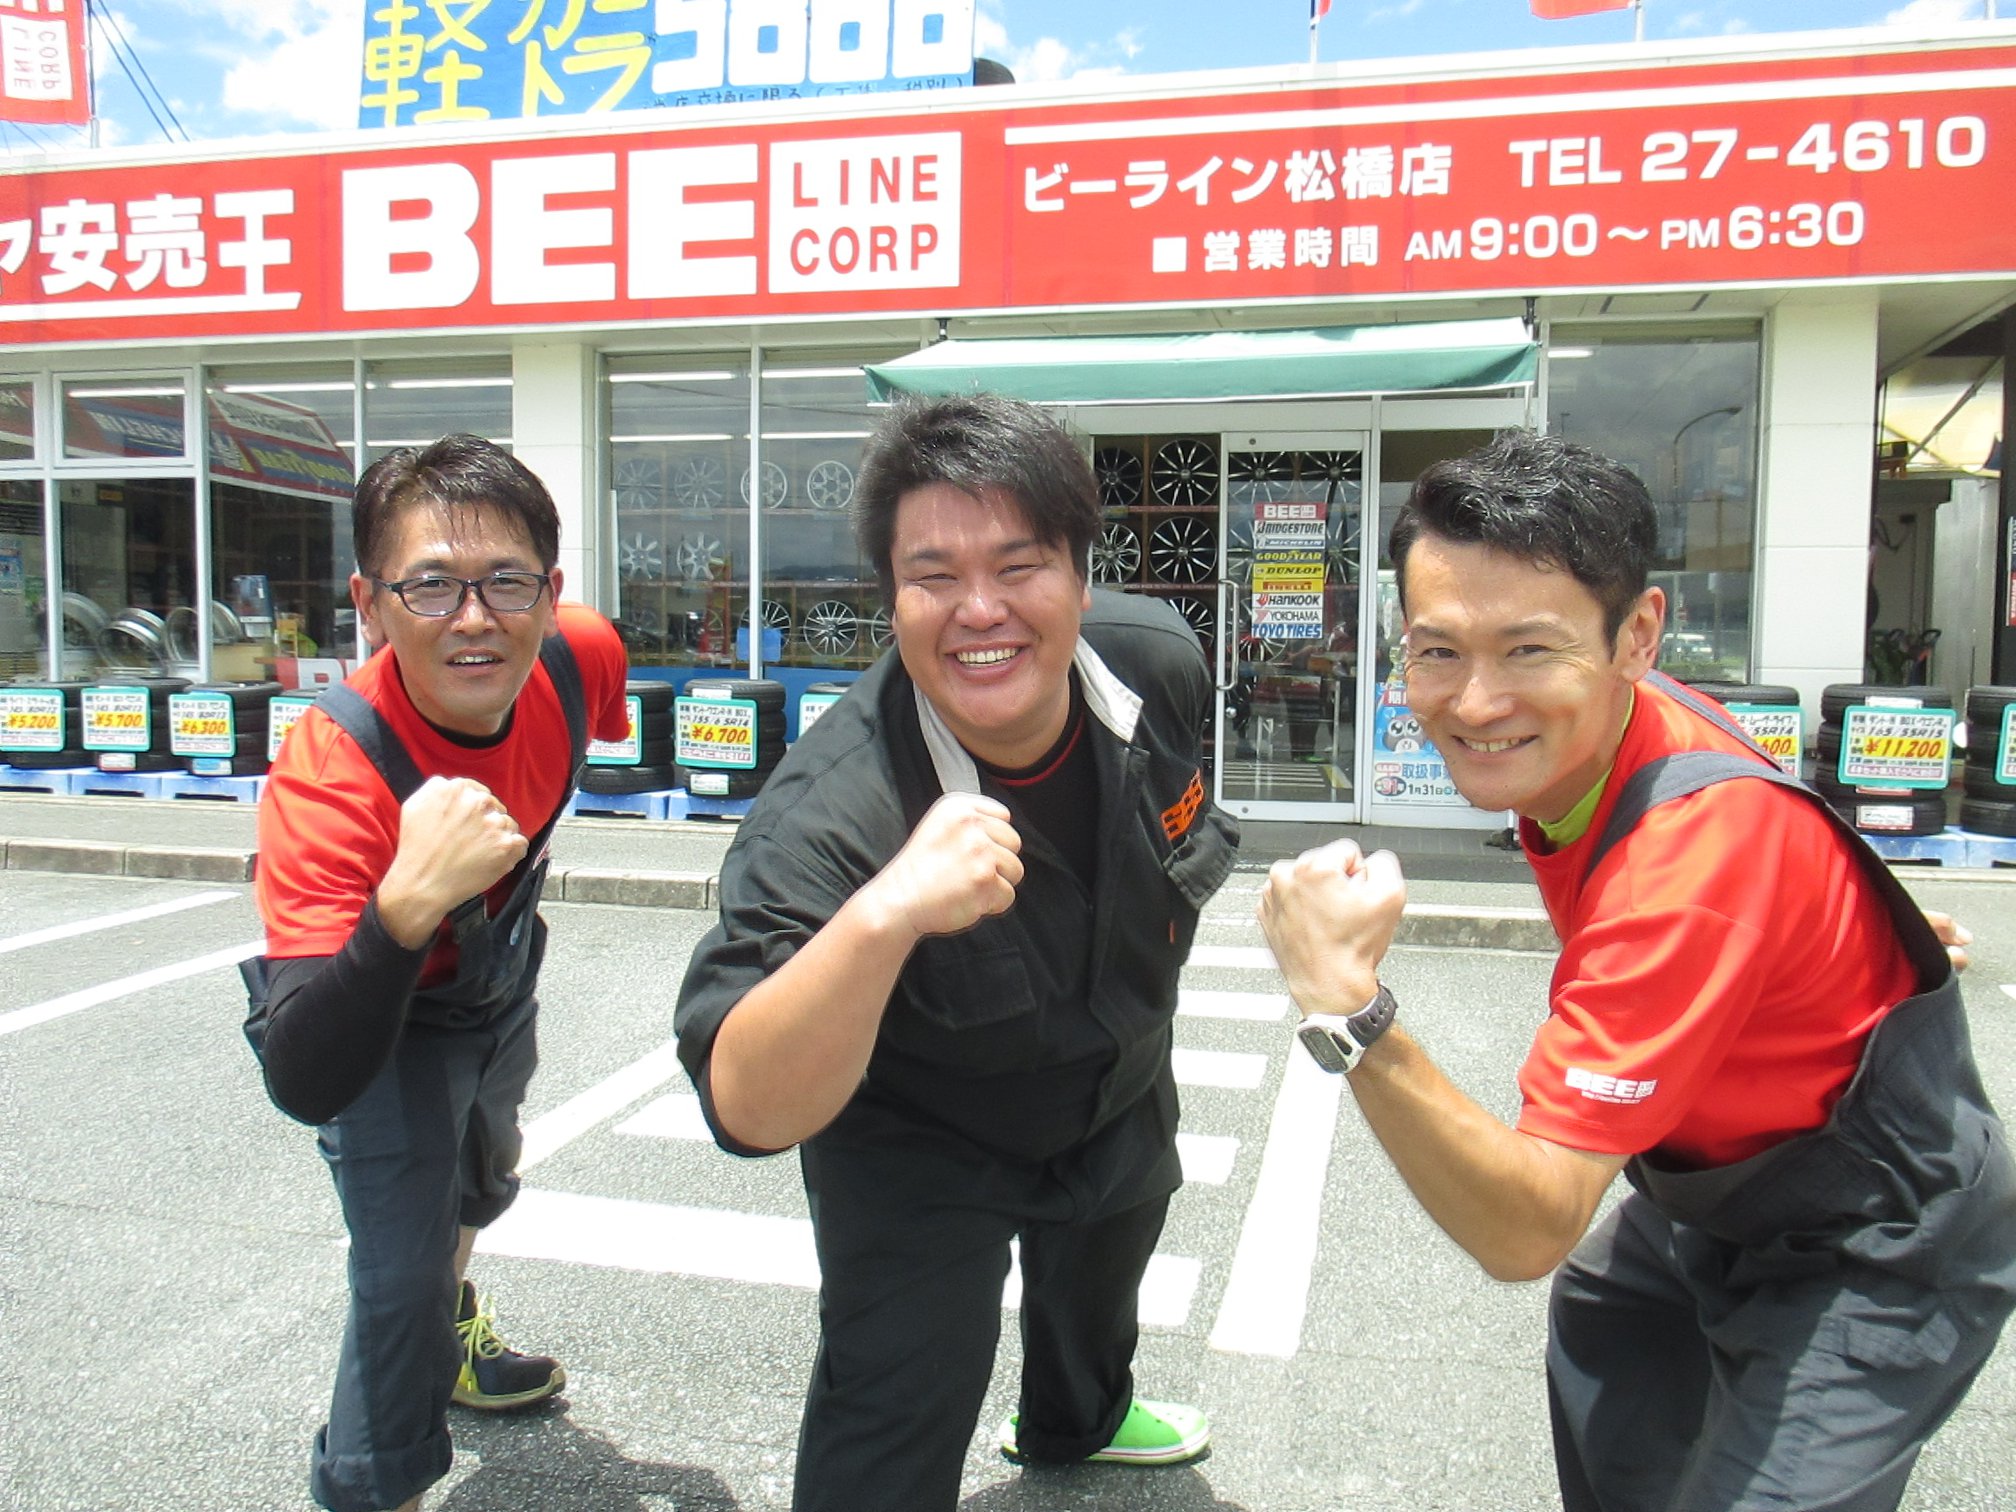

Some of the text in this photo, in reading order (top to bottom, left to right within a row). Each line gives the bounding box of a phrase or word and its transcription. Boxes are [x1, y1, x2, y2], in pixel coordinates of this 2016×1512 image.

[793, 154, 938, 208] LINE
[1024, 143, 1452, 212] ビーライン松橋店
[1509, 136, 1622, 188] TEL
[342, 142, 759, 312] BEE
[789, 223, 938, 276] CORP
[1202, 224, 1380, 274] 営業時間
[1256, 520, 1325, 534] BRIDGESTONE
[1263, 503, 1301, 519] BEE
[1266, 566, 1322, 575] DUNLOP
[1251, 623, 1321, 638] TOYO TIRES
[1270, 610, 1319, 621] YOKOHAMA
